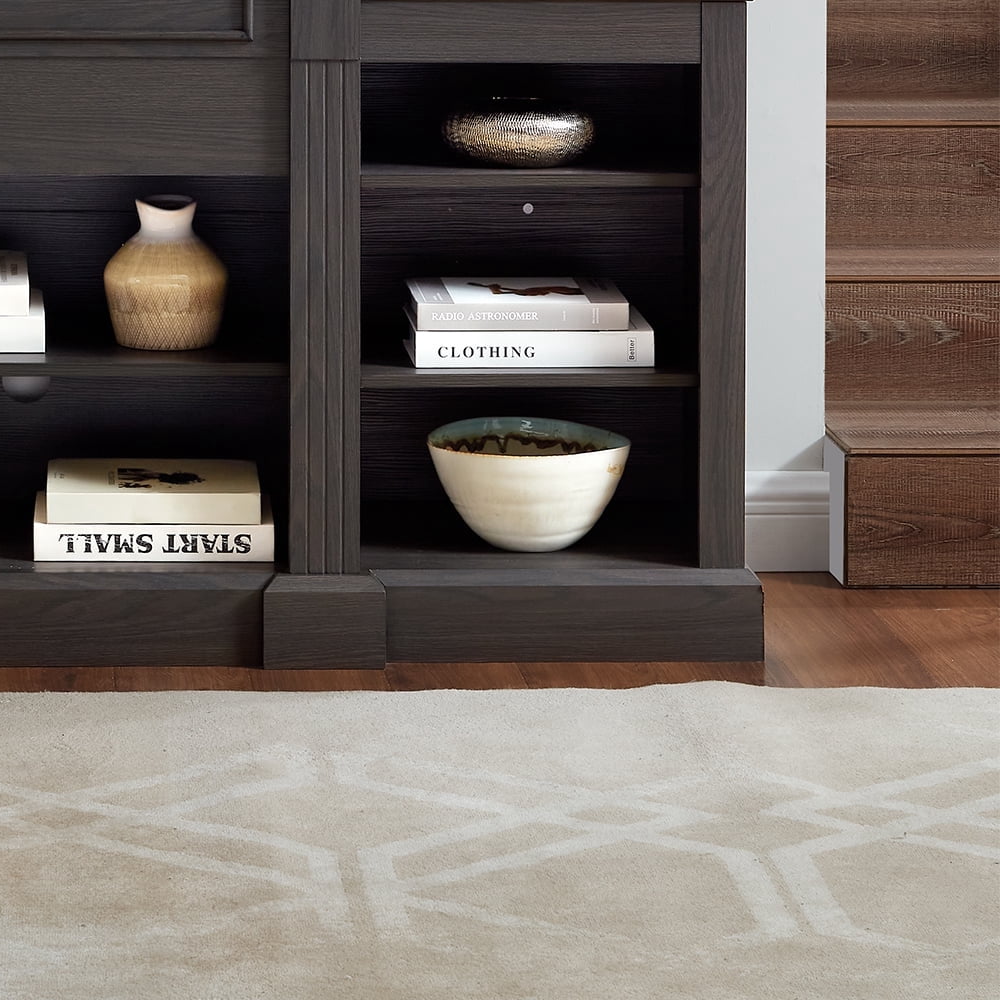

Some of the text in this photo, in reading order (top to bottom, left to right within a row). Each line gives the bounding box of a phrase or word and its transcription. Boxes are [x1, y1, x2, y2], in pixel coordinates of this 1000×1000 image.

[431, 311, 539, 321] RADIO ASTRONOMER
[437, 346, 536, 358] CLOTHING
[628, 339, 636, 361] Better
[58, 533, 252, 554] START SMALL
